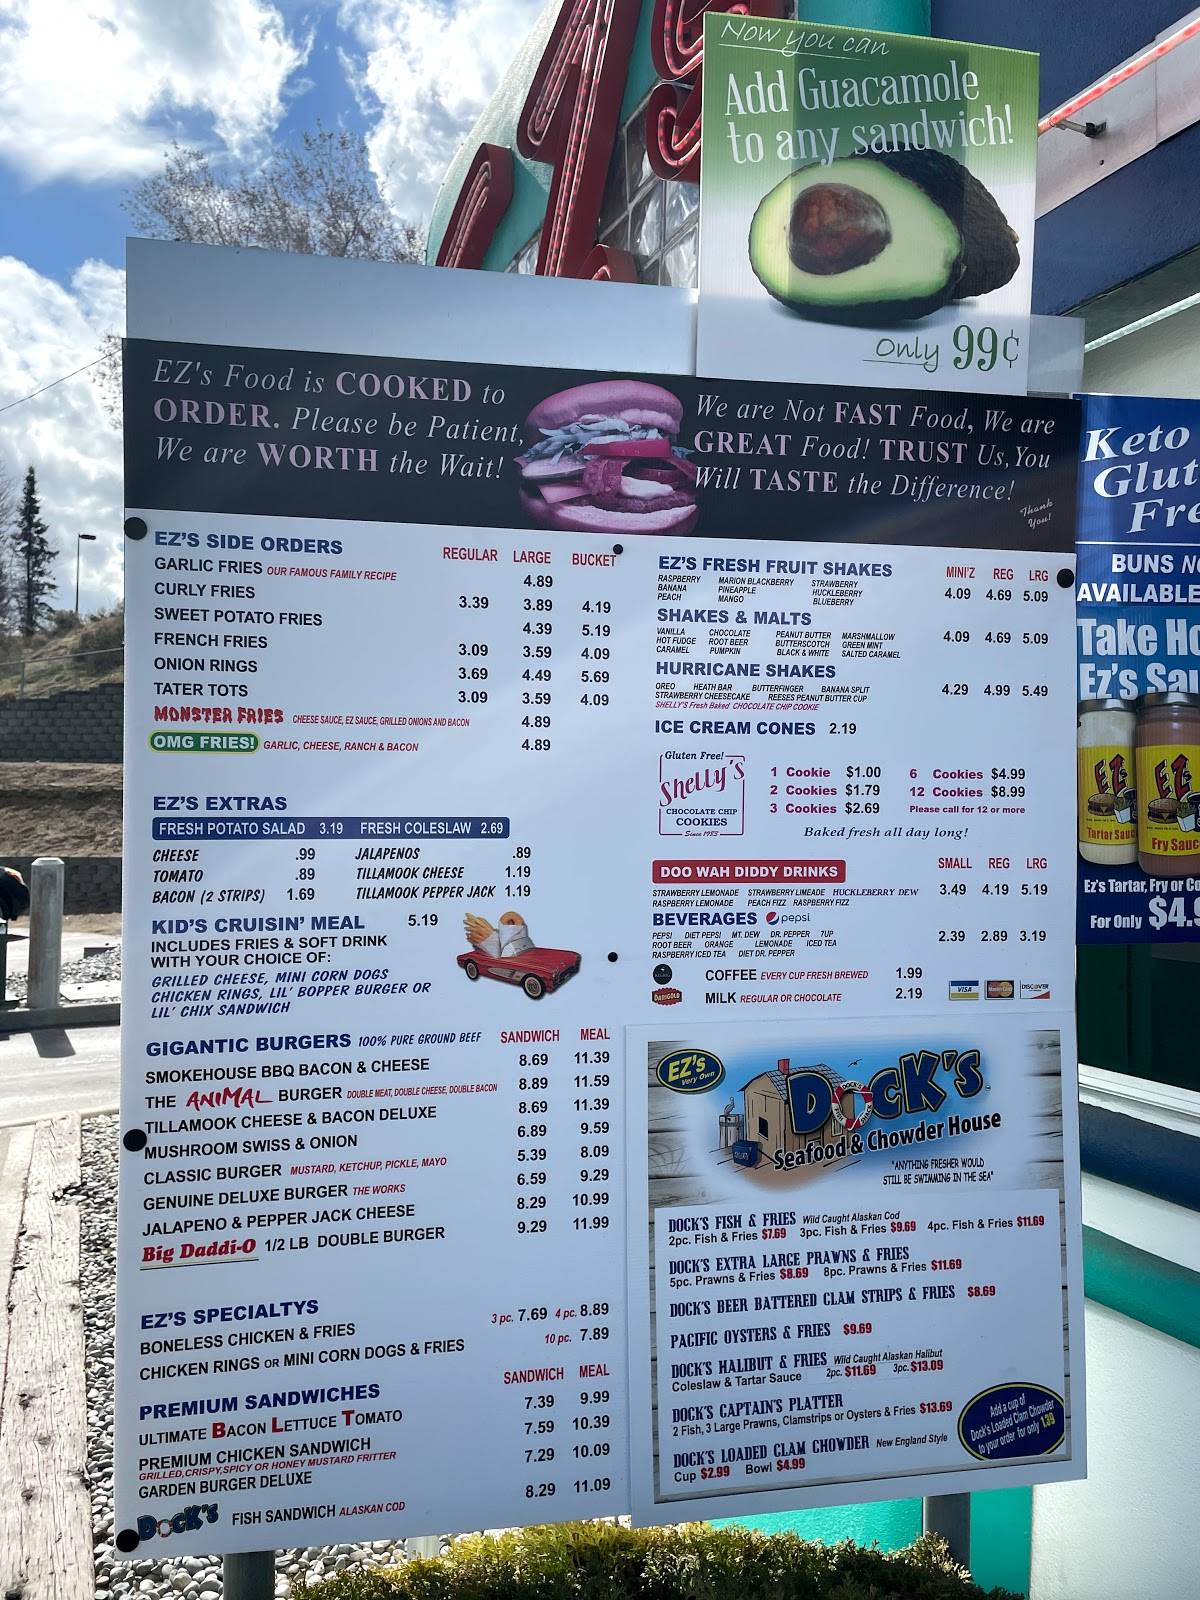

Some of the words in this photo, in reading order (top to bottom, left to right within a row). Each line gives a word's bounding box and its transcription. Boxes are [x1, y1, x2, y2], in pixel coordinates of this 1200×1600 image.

[721, 21, 781, 46] Now
[784, 28, 833, 57] you
[843, 38, 888, 54] can
[725, 70, 789, 115] Add
[798, 60, 980, 112] Guacamole
[727, 122, 764, 164] to
[776, 125, 846, 165] any
[854, 104, 1014, 158] sandwich!
[875, 337, 938, 373] Only
[953, 325, 1019, 371] 99¢
[153, 359, 212, 385] EZ's
[224, 364, 294, 390] Food
[305, 371, 324, 393] is
[336, 372, 471, 401] COOKED
[483, 385, 504, 404] to
[154, 398, 279, 428] ORDER.
[292, 407, 377, 434] Please
[389, 413, 416, 436] be
[428, 416, 523, 446] Patient,
[698, 395, 727, 417] We
[737, 404, 774, 419] are
[784, 400, 824, 422] Not
[834, 402, 901, 425] FAST
[909, 406, 973, 434] Food,
[985, 410, 1012, 431] We
[1021, 419, 1054, 434] are
[695, 431, 791, 455] GREAT
[801, 436, 870, 459] Food!
[880, 439, 967, 463] TRUST
[1016, 447, 1050, 468] You
[1081, 425, 1189, 462] Keto
[158, 437, 192, 461] We
[203, 448, 246, 464] are
[257, 443, 378, 471] WORTH
[390, 451, 427, 474] the
[441, 454, 503, 478] Wait!
[696, 467, 740, 489] Will
[750, 469, 837, 492] TASTE
[849, 473, 881, 494] the
[890, 475, 1014, 502] Difference!
[1020, 500, 1053, 517] Thank
[1028, 513, 1051, 529] You!
[155, 531, 199, 547] EZ'S
[207, 534, 253, 550] SIDE
[261, 537, 342, 554] ORDERS
[444, 547, 497, 561] REGULAR
[514, 551, 551, 563] LARGE
[572, 554, 616, 567] BUCKET
[659, 556, 696, 570] EZ'S
[703, 558, 760, 572] FRESH
[767, 560, 818, 574] FRUIT
[823, 562, 892, 577] SHAKES
[1112, 554, 1173, 573] BUNS
[155, 557, 213, 571] GARLIC
[219, 560, 262, 574] FRIES
[267, 567, 287, 575] OUR
[289, 568, 327, 577] FAMOUS
[330, 570, 362, 579] FAMILY
[364, 571, 397, 580] RECIPE
[658, 575, 701, 583] RASPBERRY
[947, 567, 975, 578] MINI'Z
[994, 568, 1013, 580] REG
[1030, 570, 1048, 581] LRG
[1078, 619, 1157, 656] Take
[1080, 663, 1138, 700] Ez's
[154, 706, 232, 723] MONSTER
[237, 707, 283, 724] FRIES
[656, 720, 683, 733] ICE
[690, 721, 750, 734] CREAM
[757, 722, 815, 735] CONES
[830, 723, 856, 734] 2.19
[771, 767, 776, 776] 1
[787, 767, 830, 777] Cookie
[847, 766, 881, 778] $1.00
[160, 823, 203, 835] FRESH
[208, 822, 258, 834] POTATO
[263, 823, 305, 834] SALAD
[320, 823, 343, 834] 3.19
[1087, 827, 1112, 840] Tartar
[1152, 838, 1168, 851] Fry
[661, 867, 692, 877] DOO
[696, 867, 729, 877] WAH
[735, 867, 778, 877] DIDDY
[784, 867, 837, 877] DRINKS
[153, 890, 195, 903] BACON
[201, 890, 213, 905] (2
[218, 889, 264, 903] STRIPS)
[287, 888, 314, 900] 1.69
[1084, 879, 1106, 893] Ez's
[1108, 879, 1147, 893] Tartar,
[1150, 879, 1168, 893] Fry
[1171, 881, 1183, 891] or
[152, 919, 207, 934] KID'S
[215, 917, 304, 932] CRUISIN'
[312, 916, 365, 930] MEAL
[653, 912, 757, 925] BEVERAGES
[782, 913, 810, 924] pepsi
[1091, 915, 1111, 928] For
[1114, 915, 1142, 929] Only
[706, 969, 756, 981] COFFEE
[147, 1038, 248, 1056] GIGANTIC
[256, 1034, 351, 1051] BURGERS
[359, 1036, 386, 1046] 100%
[391, 1035, 414, 1045] PURE
[418, 1033, 456, 1044] GROUND
[459, 1032, 481, 1042] BEEF
[773, 1135, 846, 1170] Seafood
[850, 1134, 864, 1155] &
[867, 1120, 945, 1151] Chowder
[949, 1113, 1000, 1136] House
[144, 1169, 211, 1184] CLASSIC
[217, 1164, 281, 1179] BURGER
[291, 1164, 336, 1175] MUSTARD,
[339, 1161, 382, 1171] KETCHUP,
[386, 1159, 418, 1168] PICKLE,
[422, 1157, 446, 1166] MAYO
[668, 1216, 709, 1233] DOCK'S
[716, 1215, 742, 1229] FISH
[749, 1214, 756, 1227] &
[763, 1212, 796, 1226] FRIES
[803, 1215, 820, 1224] Wild
[822, 1214, 849, 1224] Caught
[851, 1213, 882, 1221] Alaskan
[885, 1211, 900, 1220] Cod
[671, 1331, 717, 1348] PACIFIC
[724, 1327, 776, 1344] OYSTERS
[783, 1326, 791, 1339] &
[797, 1323, 830, 1338] FRIES
[844, 1323, 872, 1335] $9.69
[675, 1472, 696, 1483] Cup
[701, 1466, 729, 1479] $2.99
[746, 1462, 772, 1474] Bowl
[777, 1458, 805, 1471] $4.99
[233, 1511, 261, 1525] FISH
[266, 1505, 335, 1522] SANDWICH
[339, 1504, 383, 1516] ALASKAN
[386, 1502, 405, 1512] COD
